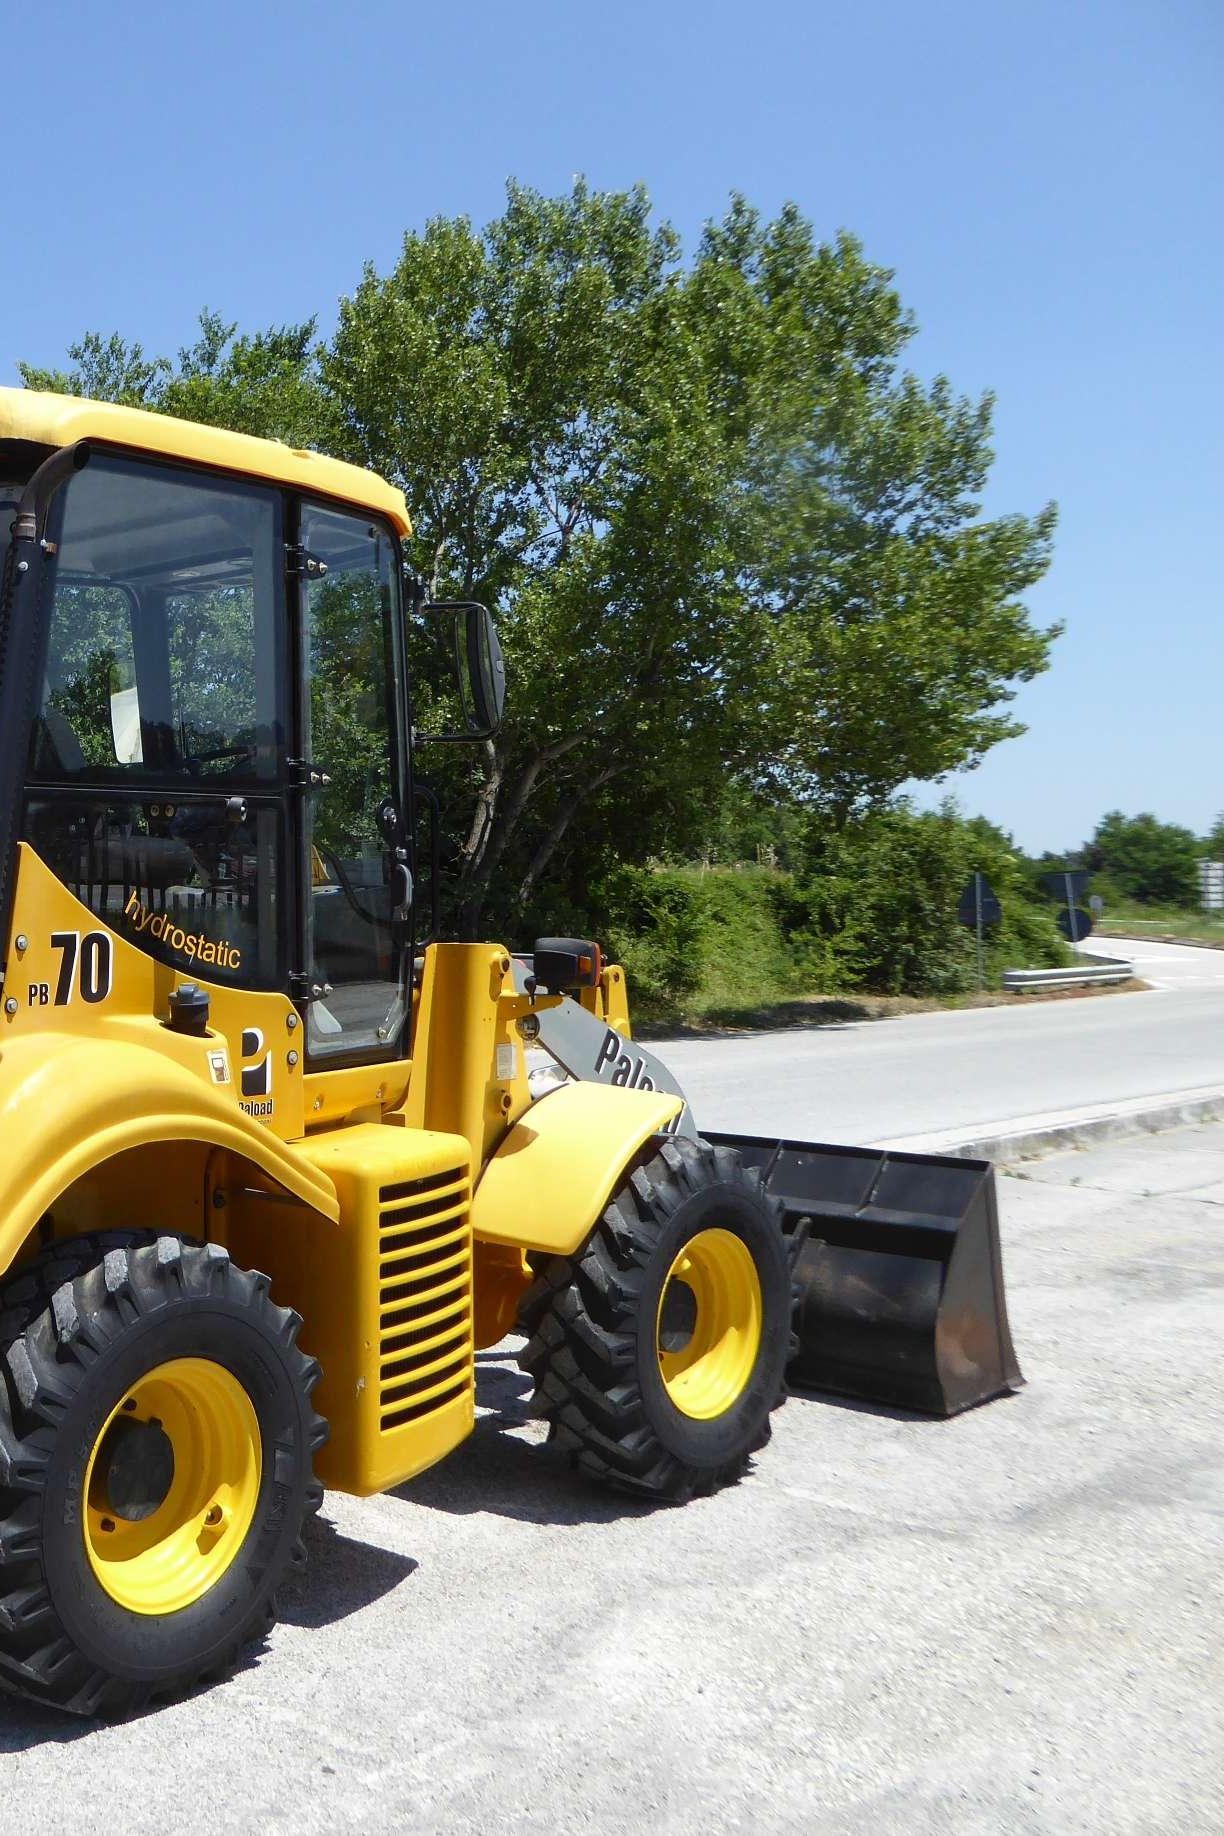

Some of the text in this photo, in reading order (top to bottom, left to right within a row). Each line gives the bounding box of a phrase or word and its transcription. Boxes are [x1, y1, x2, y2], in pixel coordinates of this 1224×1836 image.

[124, 889, 241, 969] hydrostatic
[28, 930, 114, 1007] PB 70
